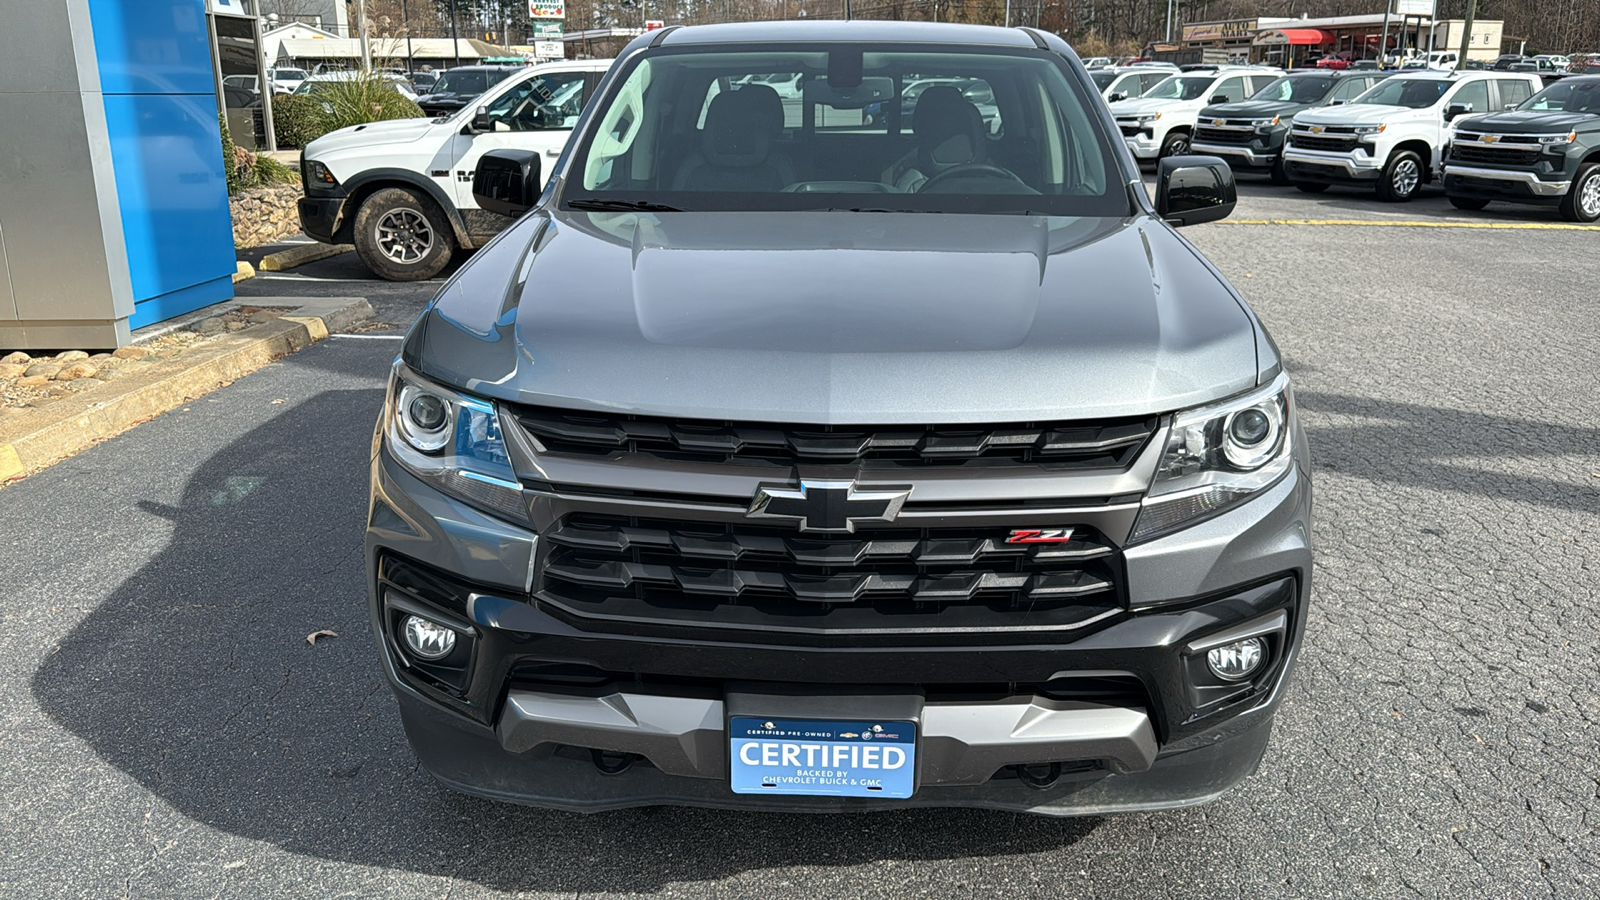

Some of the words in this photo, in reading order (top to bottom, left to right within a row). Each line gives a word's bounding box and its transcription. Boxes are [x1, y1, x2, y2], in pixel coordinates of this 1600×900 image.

[1222, 21, 1249, 31] AUTO
[1220, 30, 1248, 38] MART
[1004, 527, 1075, 543] Z71
[739, 742, 906, 770] CERTIFIED
[796, 769, 833, 778] BACKED
[763, 776, 816, 784] CHEVROLET
[820, 777, 848, 785] BUICK
[850, 778, 857, 786] &
[860, 779, 882, 787] GMC
